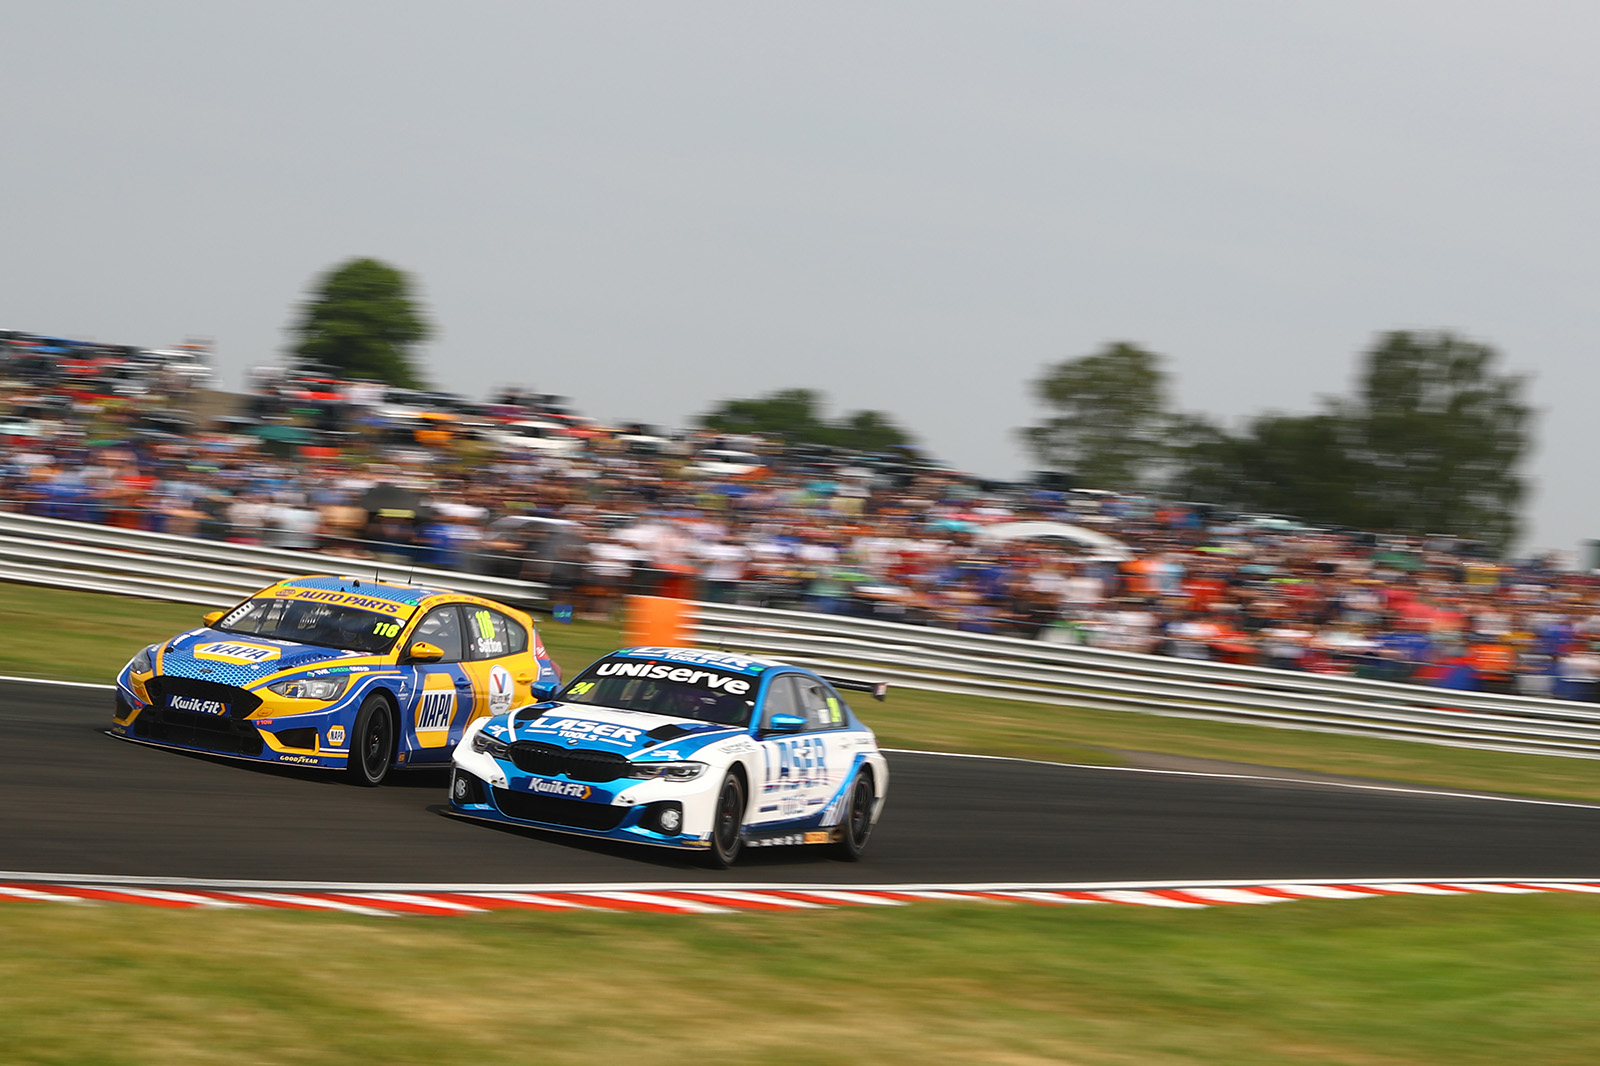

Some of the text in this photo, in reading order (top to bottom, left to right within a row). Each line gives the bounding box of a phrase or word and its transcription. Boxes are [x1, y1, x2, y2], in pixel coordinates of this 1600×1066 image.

[296, 591, 343, 603] AUTO
[343, 595, 401, 613] PARTS
[373, 622, 401, 638] 116
[475, 610, 496, 638] 116
[208, 644, 270, 660] NAPA
[478, 637, 503, 653] Sutton
[566, 681, 596, 695] 24
[418, 693, 452, 727] NAPA
[330, 730, 343, 741] NAPA
[530, 717, 642, 742] LASER
[557, 729, 600, 741] TOOLS
